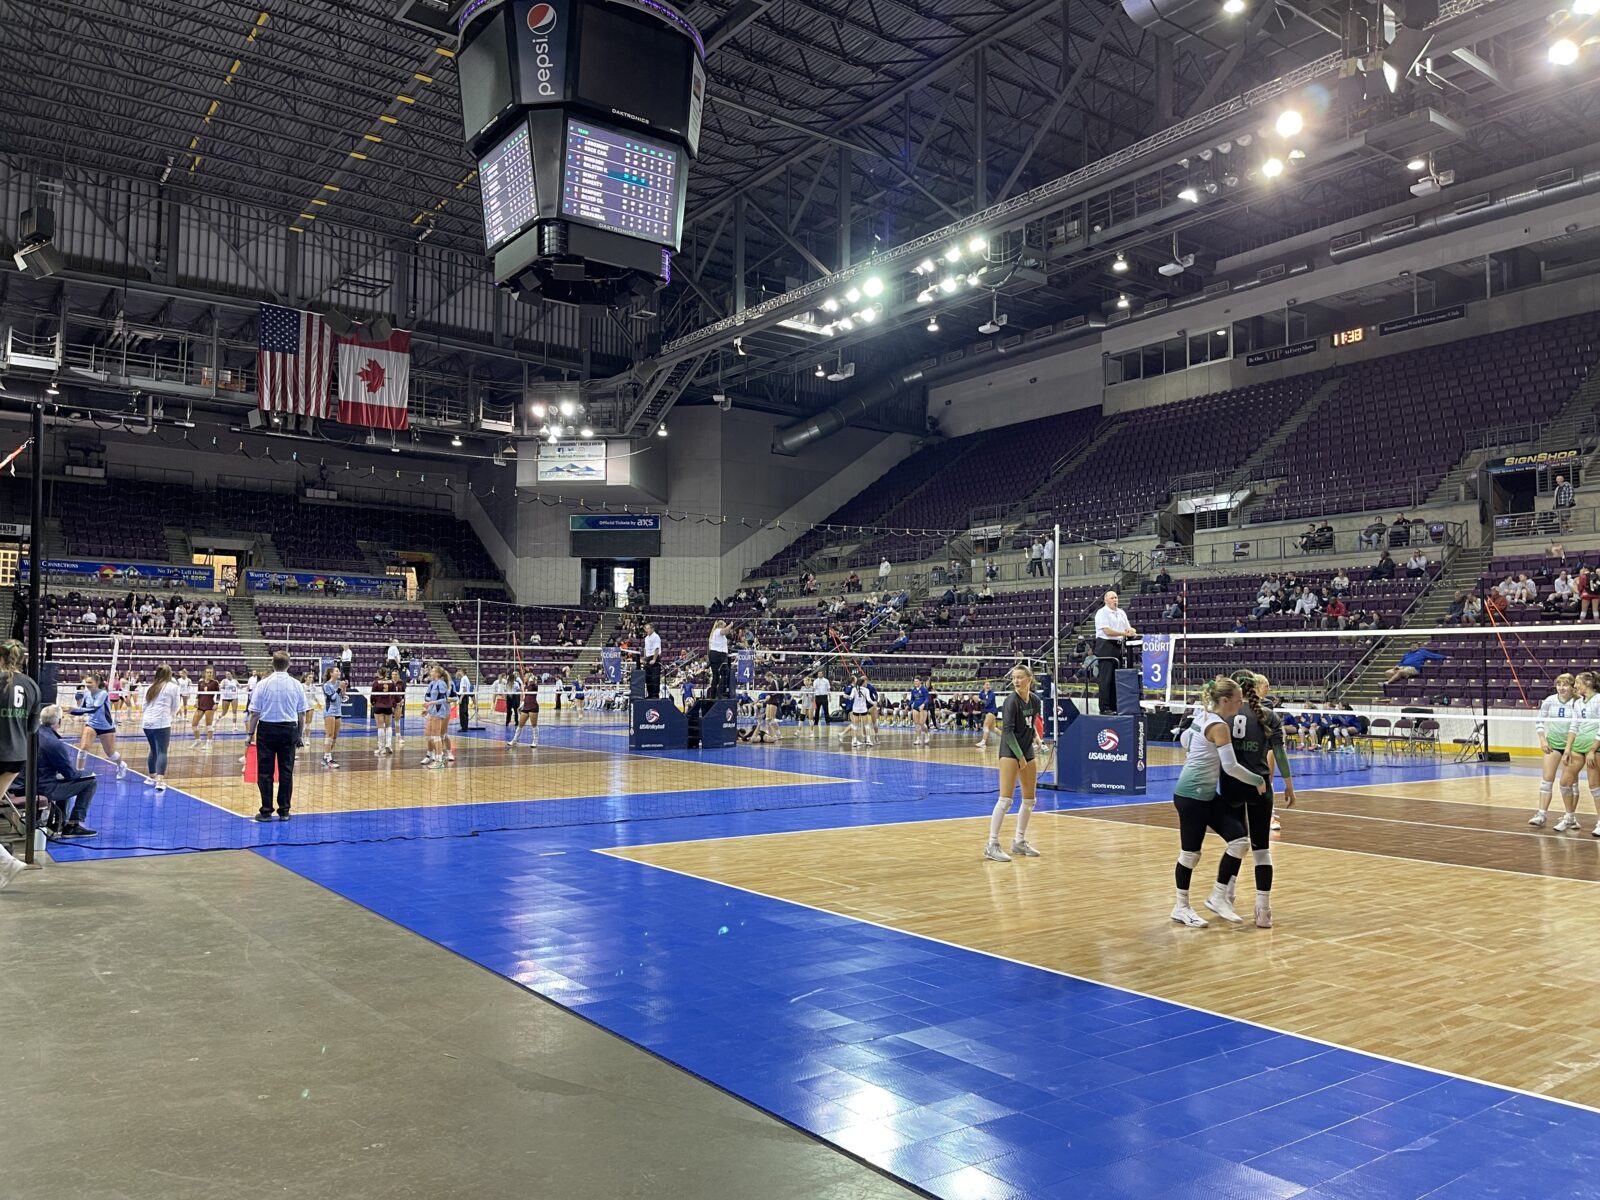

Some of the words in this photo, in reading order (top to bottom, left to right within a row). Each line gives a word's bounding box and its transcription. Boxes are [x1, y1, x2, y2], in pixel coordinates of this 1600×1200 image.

[532, 38, 555, 96] pepsi
[612, 108, 650, 125] DAKTRONICS
[1333, 328, 1362, 346] 11:38
[1265, 350, 1283, 361] VIP
[637, 518, 654, 527] axs
[1142, 641, 1170, 652] COURT
[608, 665, 616, 678] 2
[743, 667, 751, 679] 4
[1151, 663, 1162, 683] 3
[13, 685, 25, 708] 6
[1558, 707, 1565, 718] 8
[1233, 714, 1247, 739] 8
[1088, 752, 1128, 763] USAVolleyball
